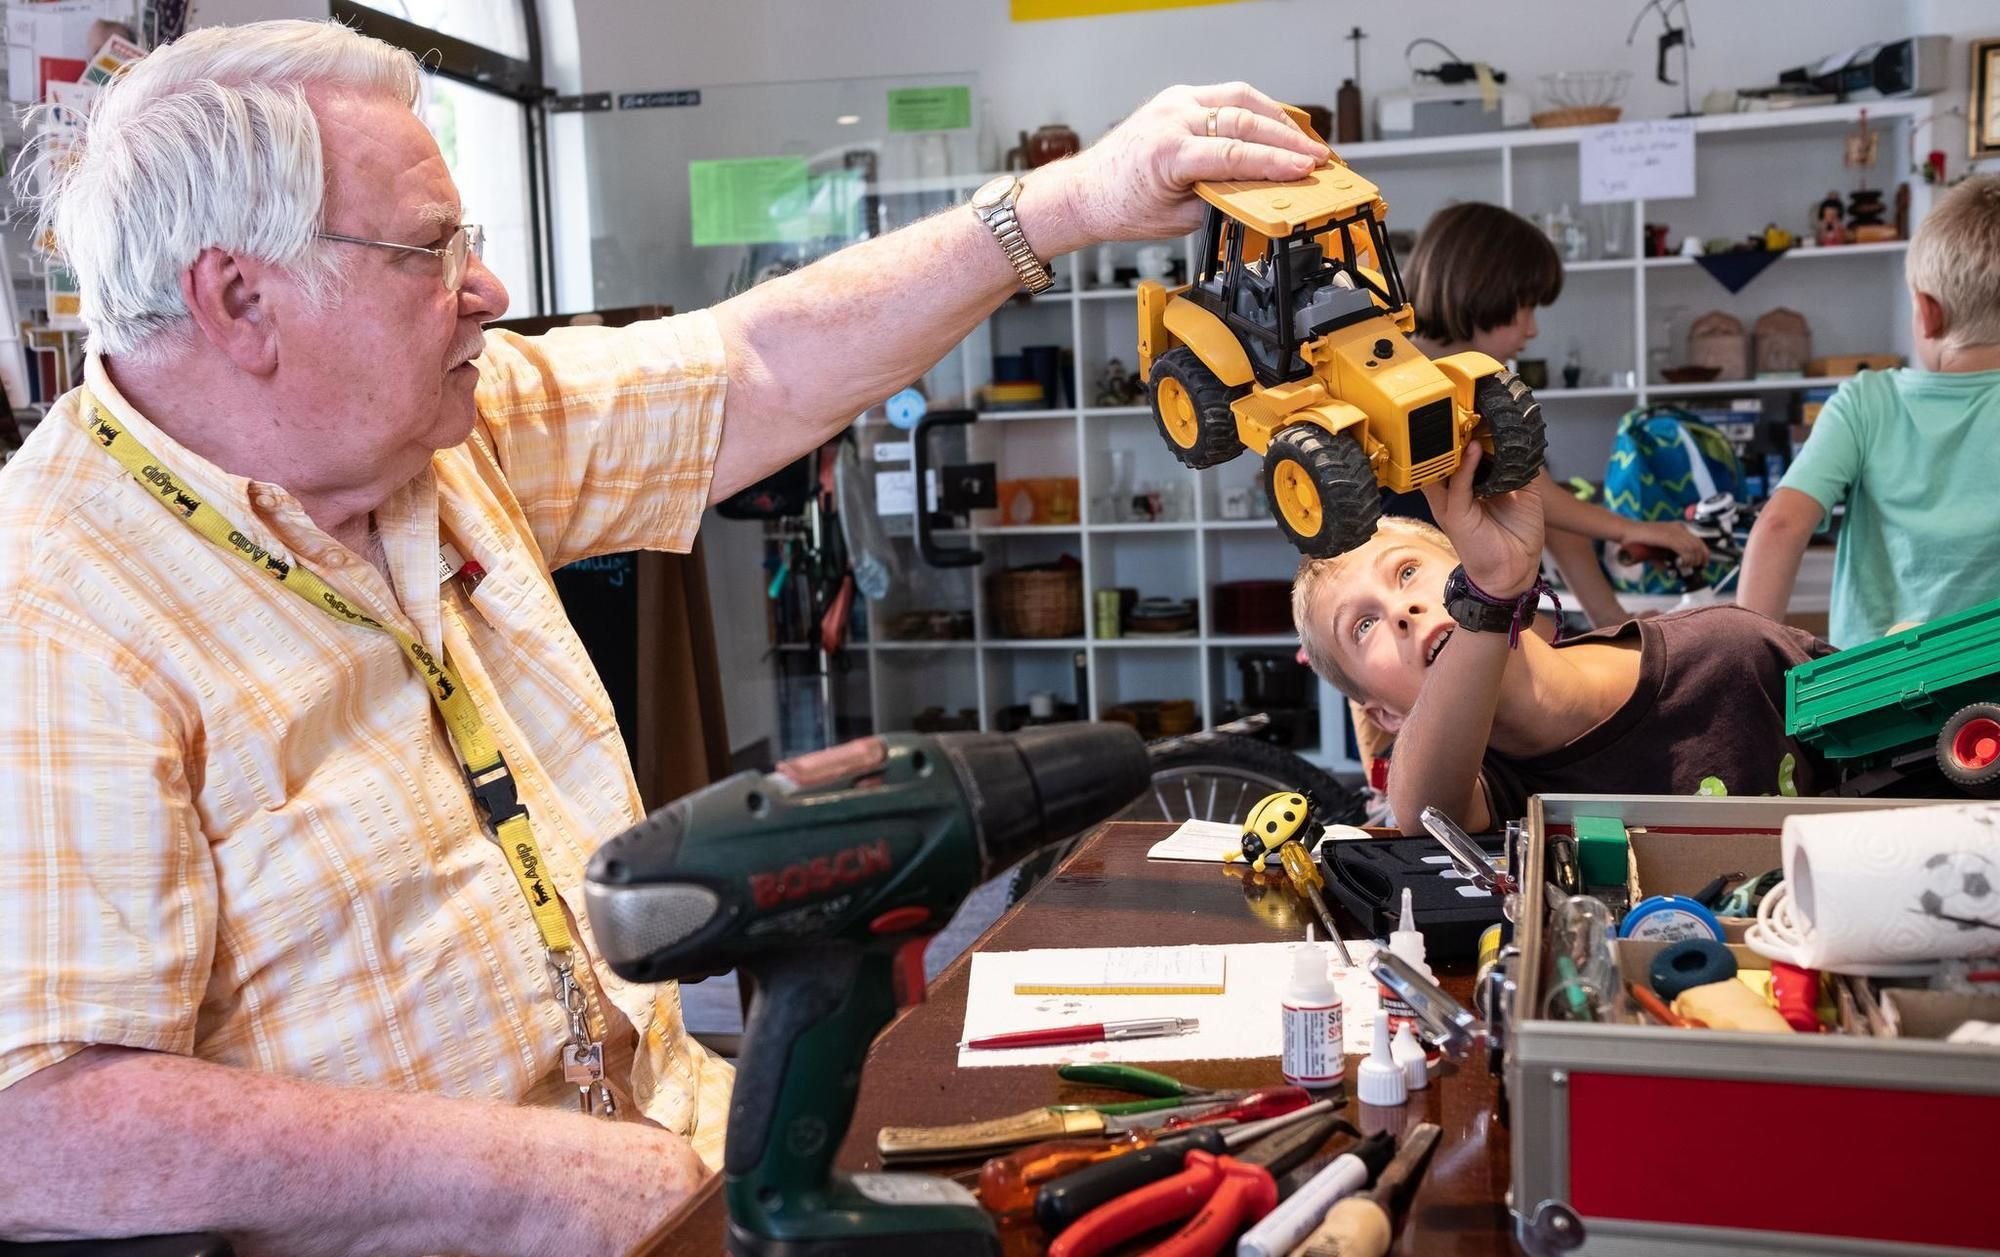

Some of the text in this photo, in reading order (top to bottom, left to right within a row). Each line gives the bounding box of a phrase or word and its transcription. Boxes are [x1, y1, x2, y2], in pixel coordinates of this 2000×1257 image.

[141, 465, 179, 497] Agip
[323, 592, 358, 619] Agip
[411, 642, 440, 676] Agip
[516, 843, 539, 878] Agip
[750, 839, 891, 910] BOSCH
